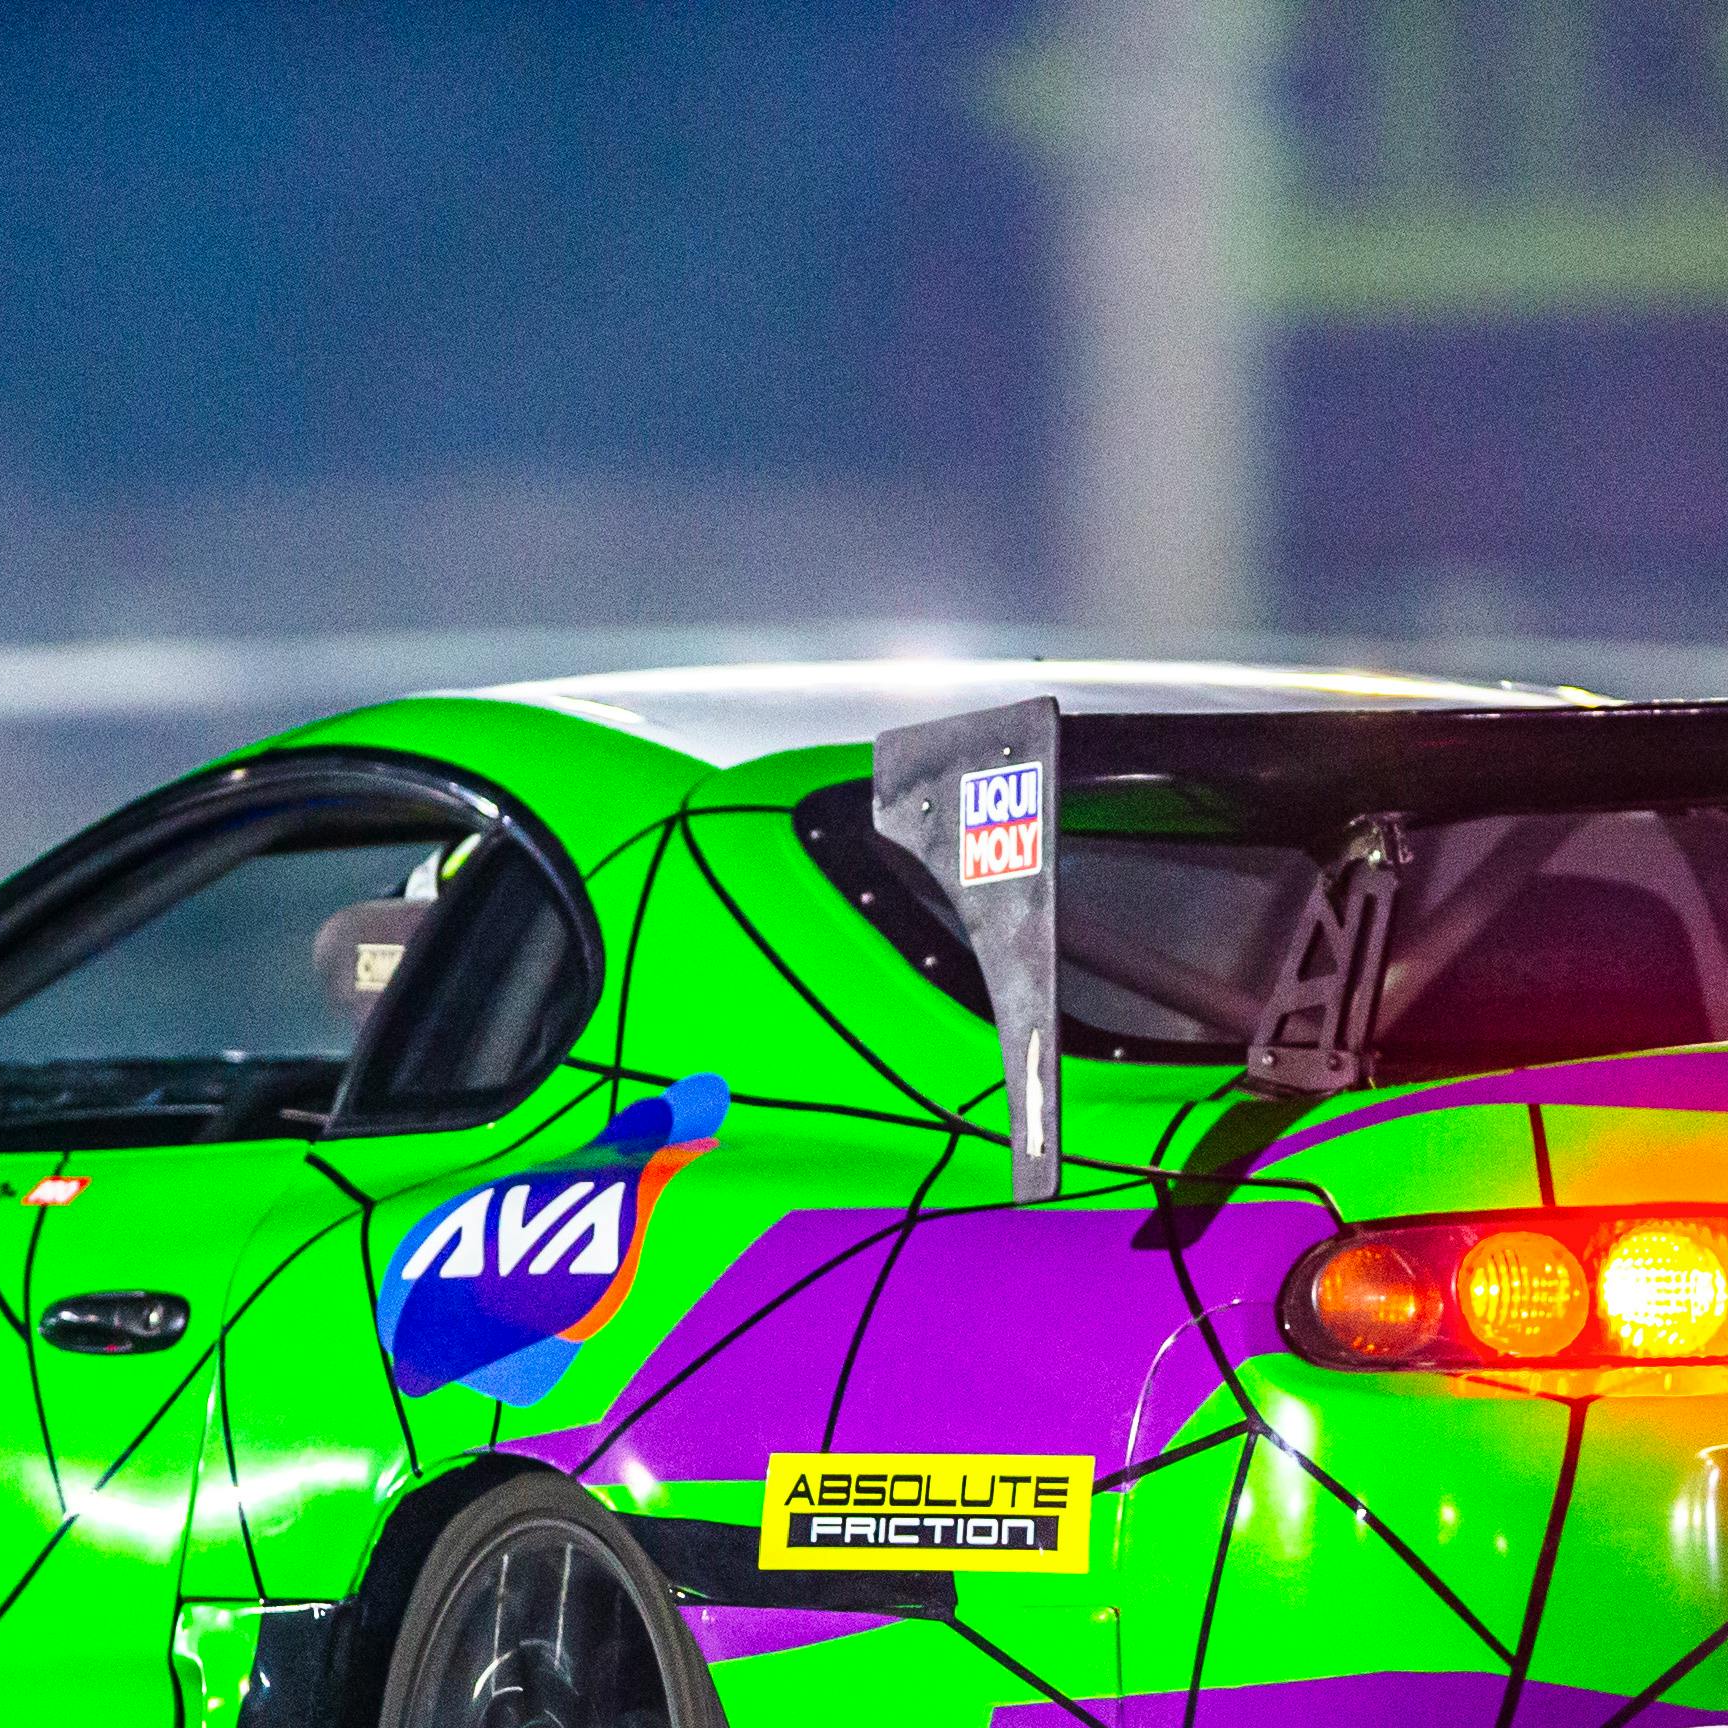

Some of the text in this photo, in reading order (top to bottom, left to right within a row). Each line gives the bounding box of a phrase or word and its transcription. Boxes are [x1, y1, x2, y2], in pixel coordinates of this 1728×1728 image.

[966, 770, 1038, 827] LIQUI
[966, 821, 1038, 878] MOLY
[401, 1181, 626, 1280] AVA
[784, 1473, 1070, 1509] ABSOLUTE
[810, 1516, 1035, 1546] FRICTION
